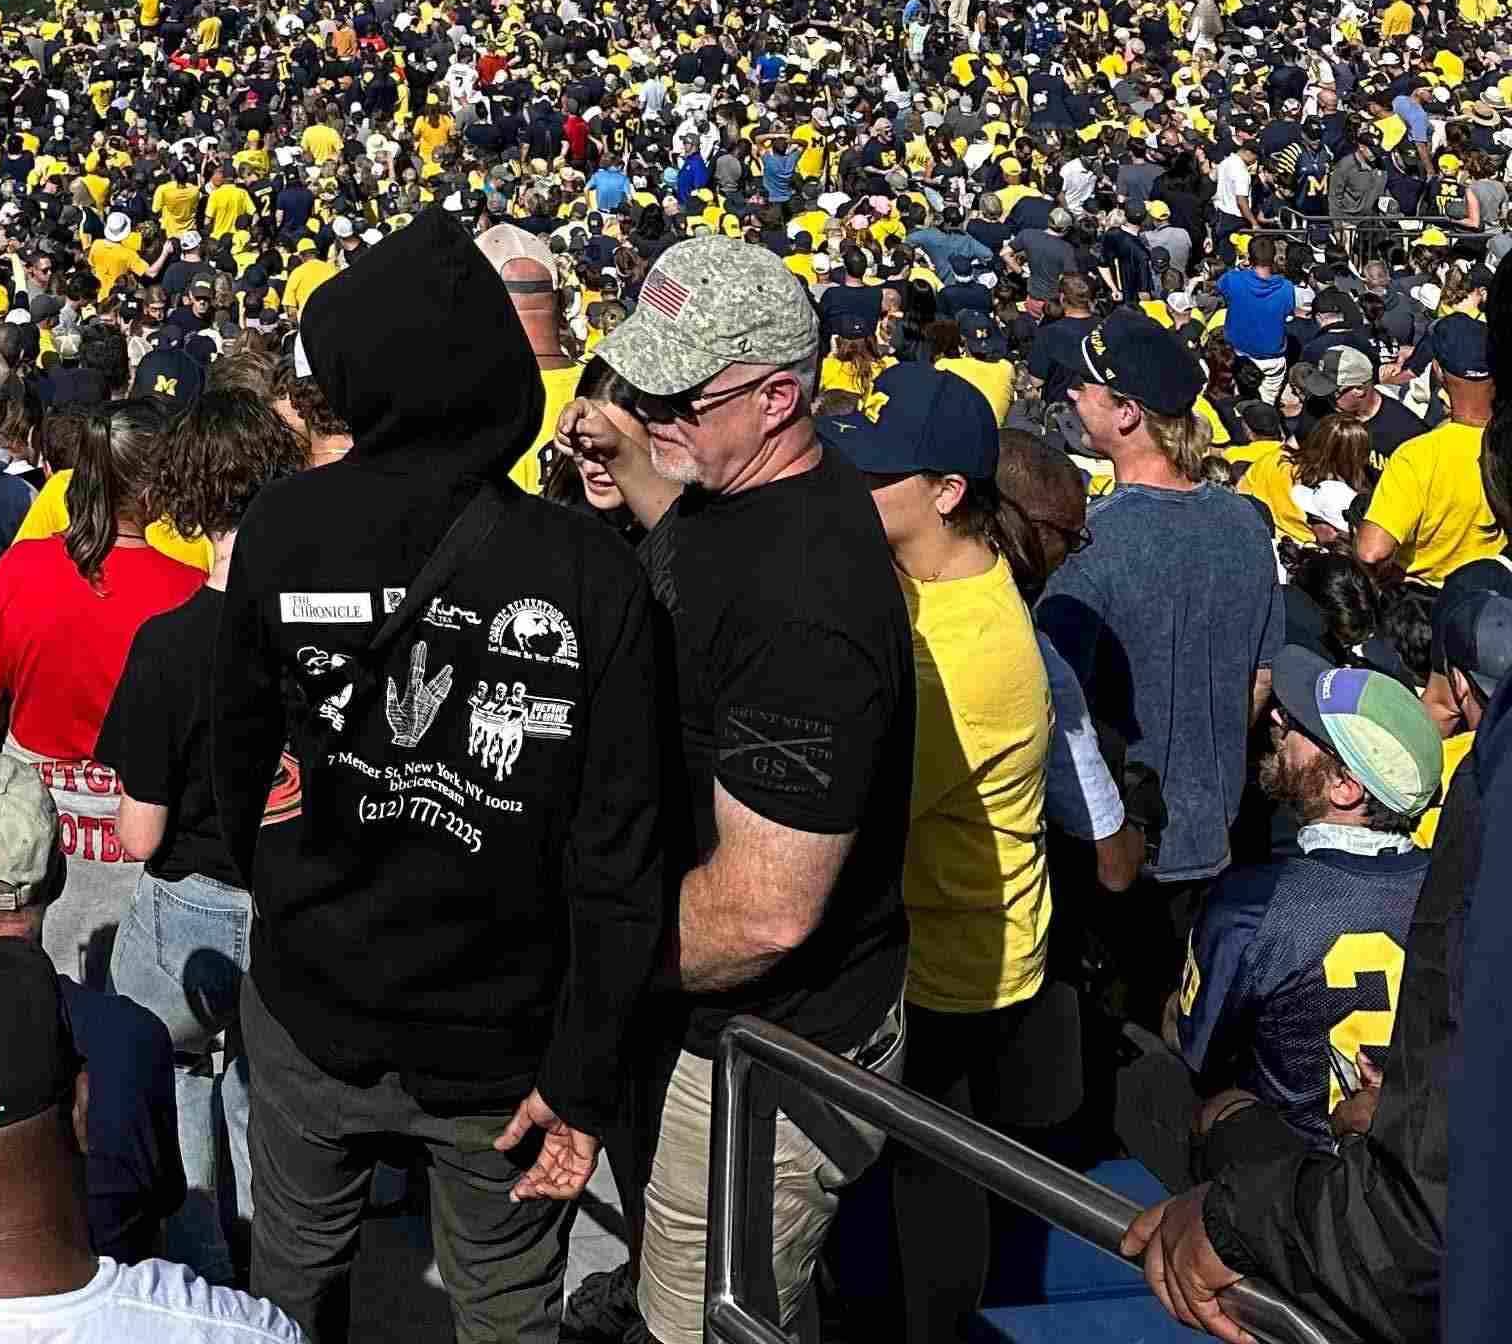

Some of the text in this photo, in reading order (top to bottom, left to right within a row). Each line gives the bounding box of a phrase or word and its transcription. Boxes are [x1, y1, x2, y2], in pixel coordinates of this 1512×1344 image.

[1307, 175, 1328, 197] M
[260, 194, 271, 217] 2
[153, 374, 178, 396] M
[292, 604, 362, 618] CHRONICLE
[752, 755, 788, 778] GS
[327, 754, 336, 766] 7
[338, 752, 382, 779] Mercer
[404, 762, 434, 776] New
[436, 762, 464, 791] York,
[465, 780, 484, 802] NY
[485, 795, 523, 812] 10012
[389, 776, 465, 807] bbcicecream
[358, 795, 482, 853] (212) 777-2225
